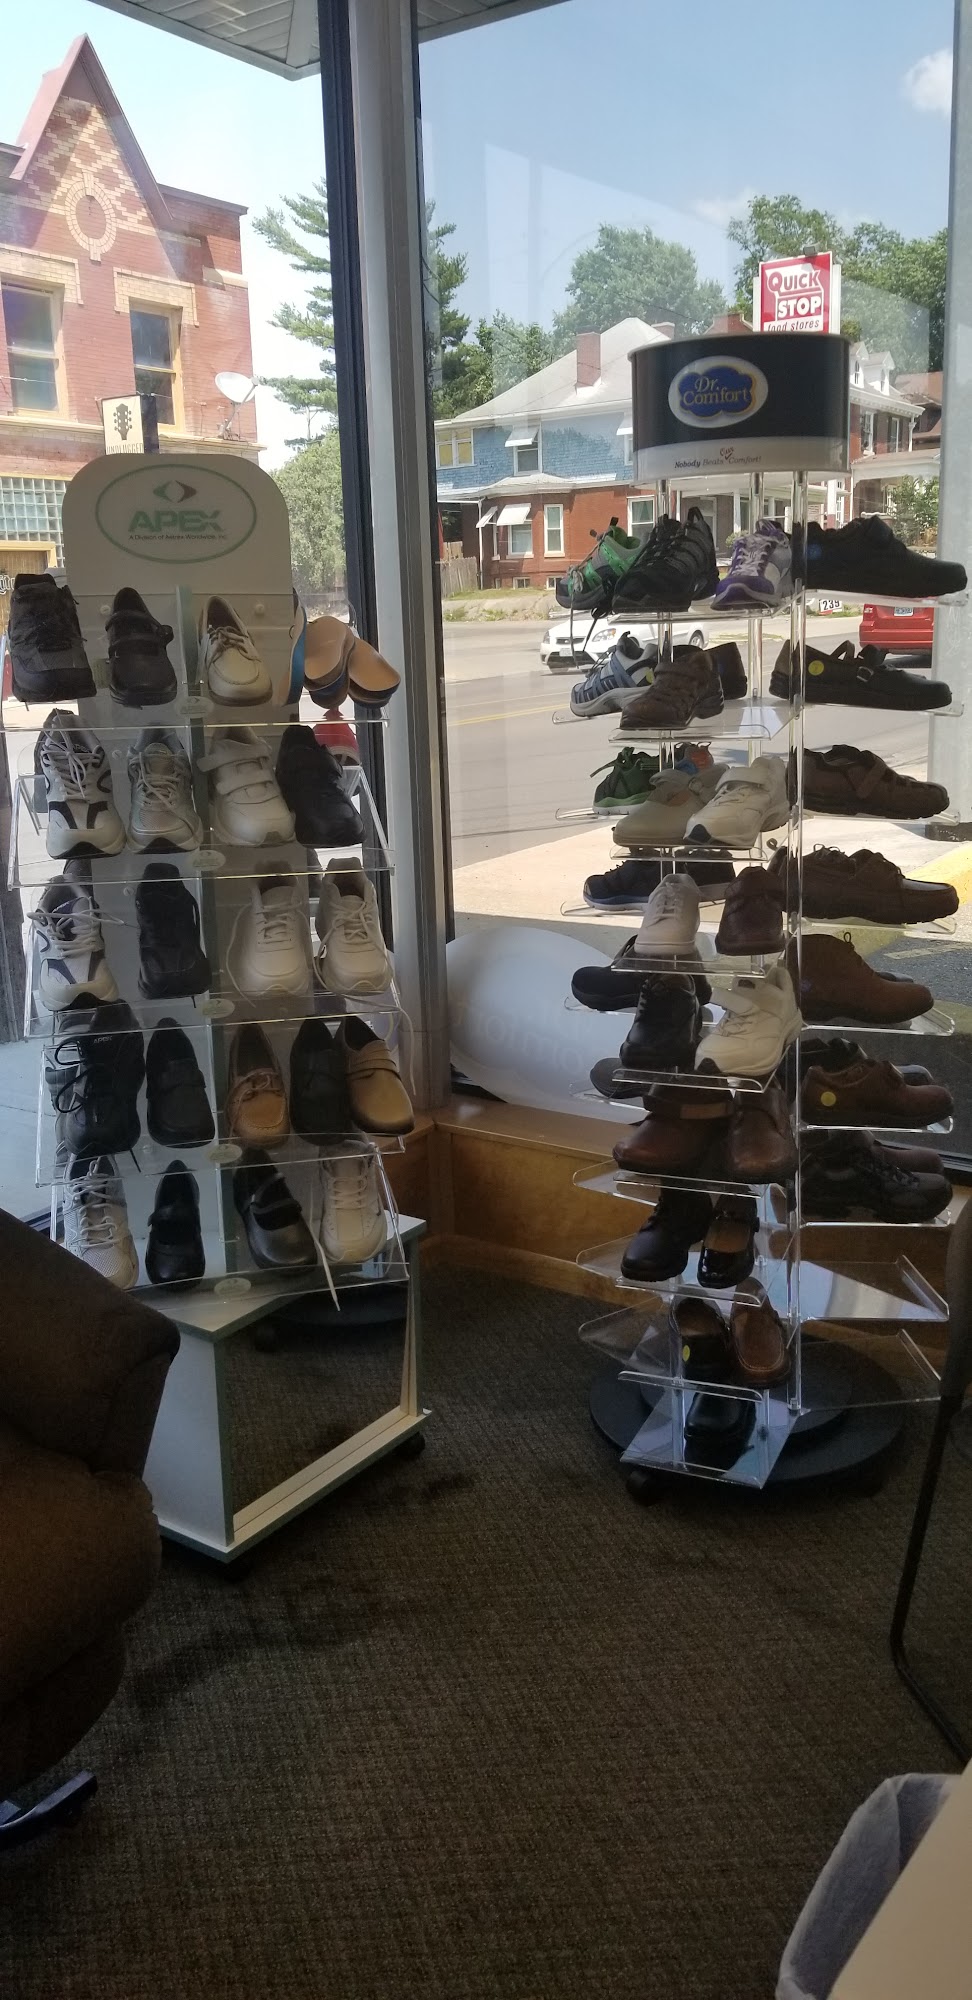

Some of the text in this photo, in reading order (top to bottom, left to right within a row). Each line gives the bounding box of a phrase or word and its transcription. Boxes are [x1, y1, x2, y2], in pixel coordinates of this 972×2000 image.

[768, 270, 820, 293] QUICK
[778, 296, 821, 318] STOP
[791, 320, 820, 331] stores
[695, 376, 719, 392] Dr.
[683, 387, 749, 406] Comfort
[675, 460, 700, 468] Nobody
[128, 510, 224, 532] APEX
[822, 600, 840, 611] 239
